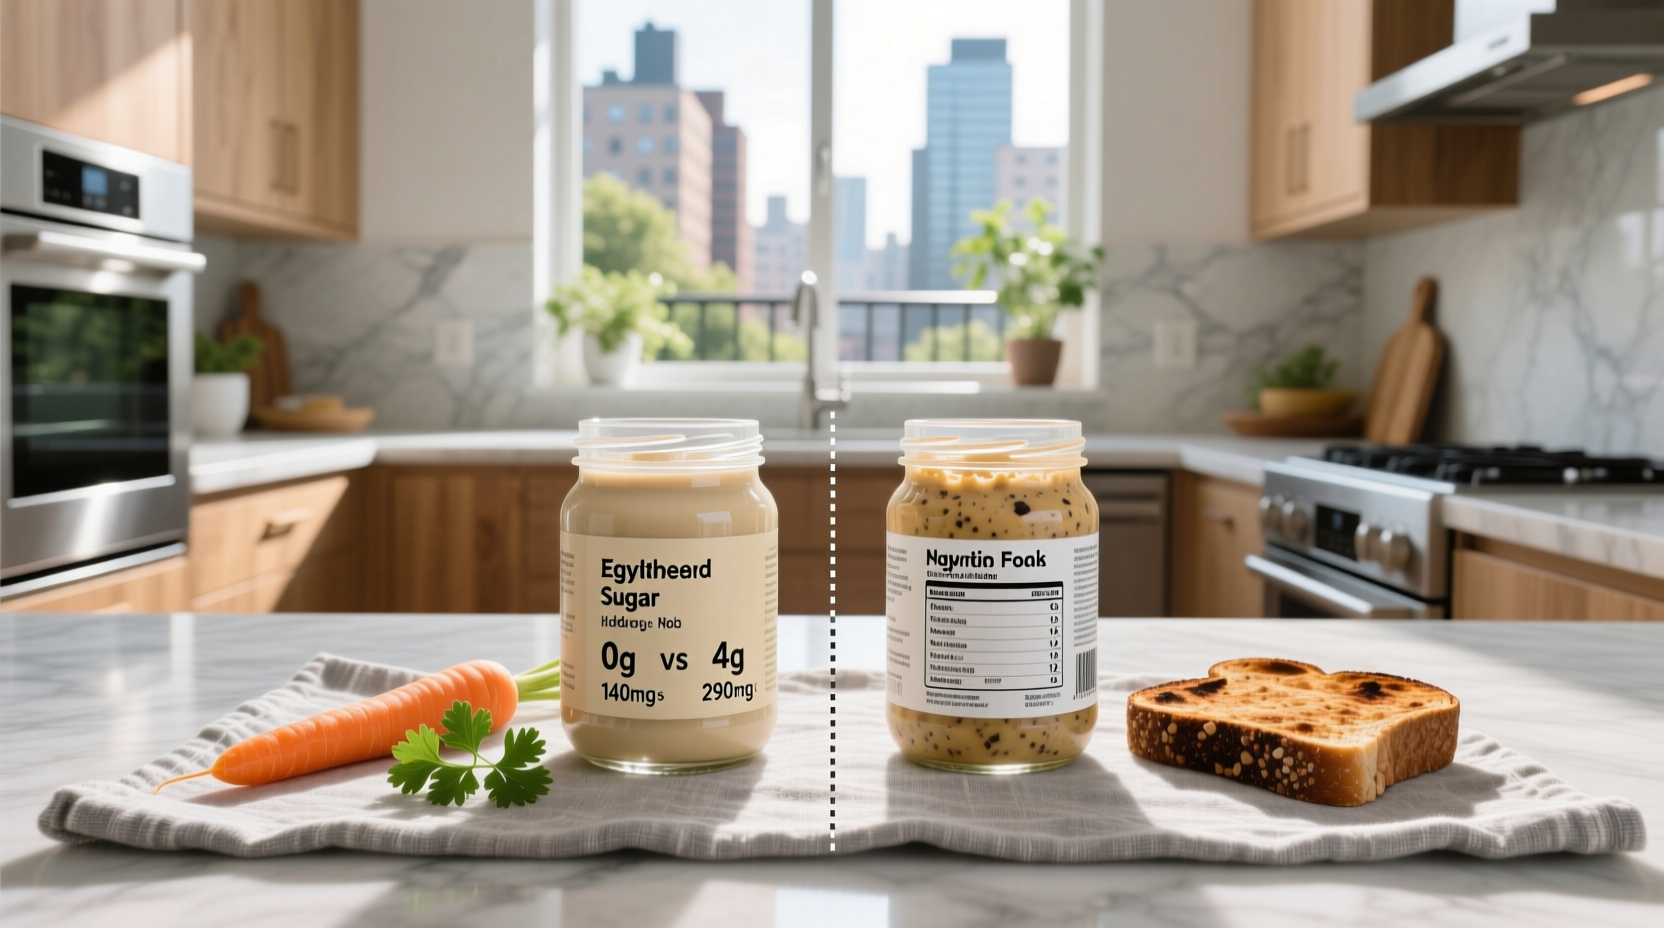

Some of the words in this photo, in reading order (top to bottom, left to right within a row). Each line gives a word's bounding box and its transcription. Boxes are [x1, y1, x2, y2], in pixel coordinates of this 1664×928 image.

[601, 586, 660, 612] Sugar
[601, 641, 636, 678] 0g
[660, 652, 688, 671] vs
[712, 641, 744, 675] 4g
